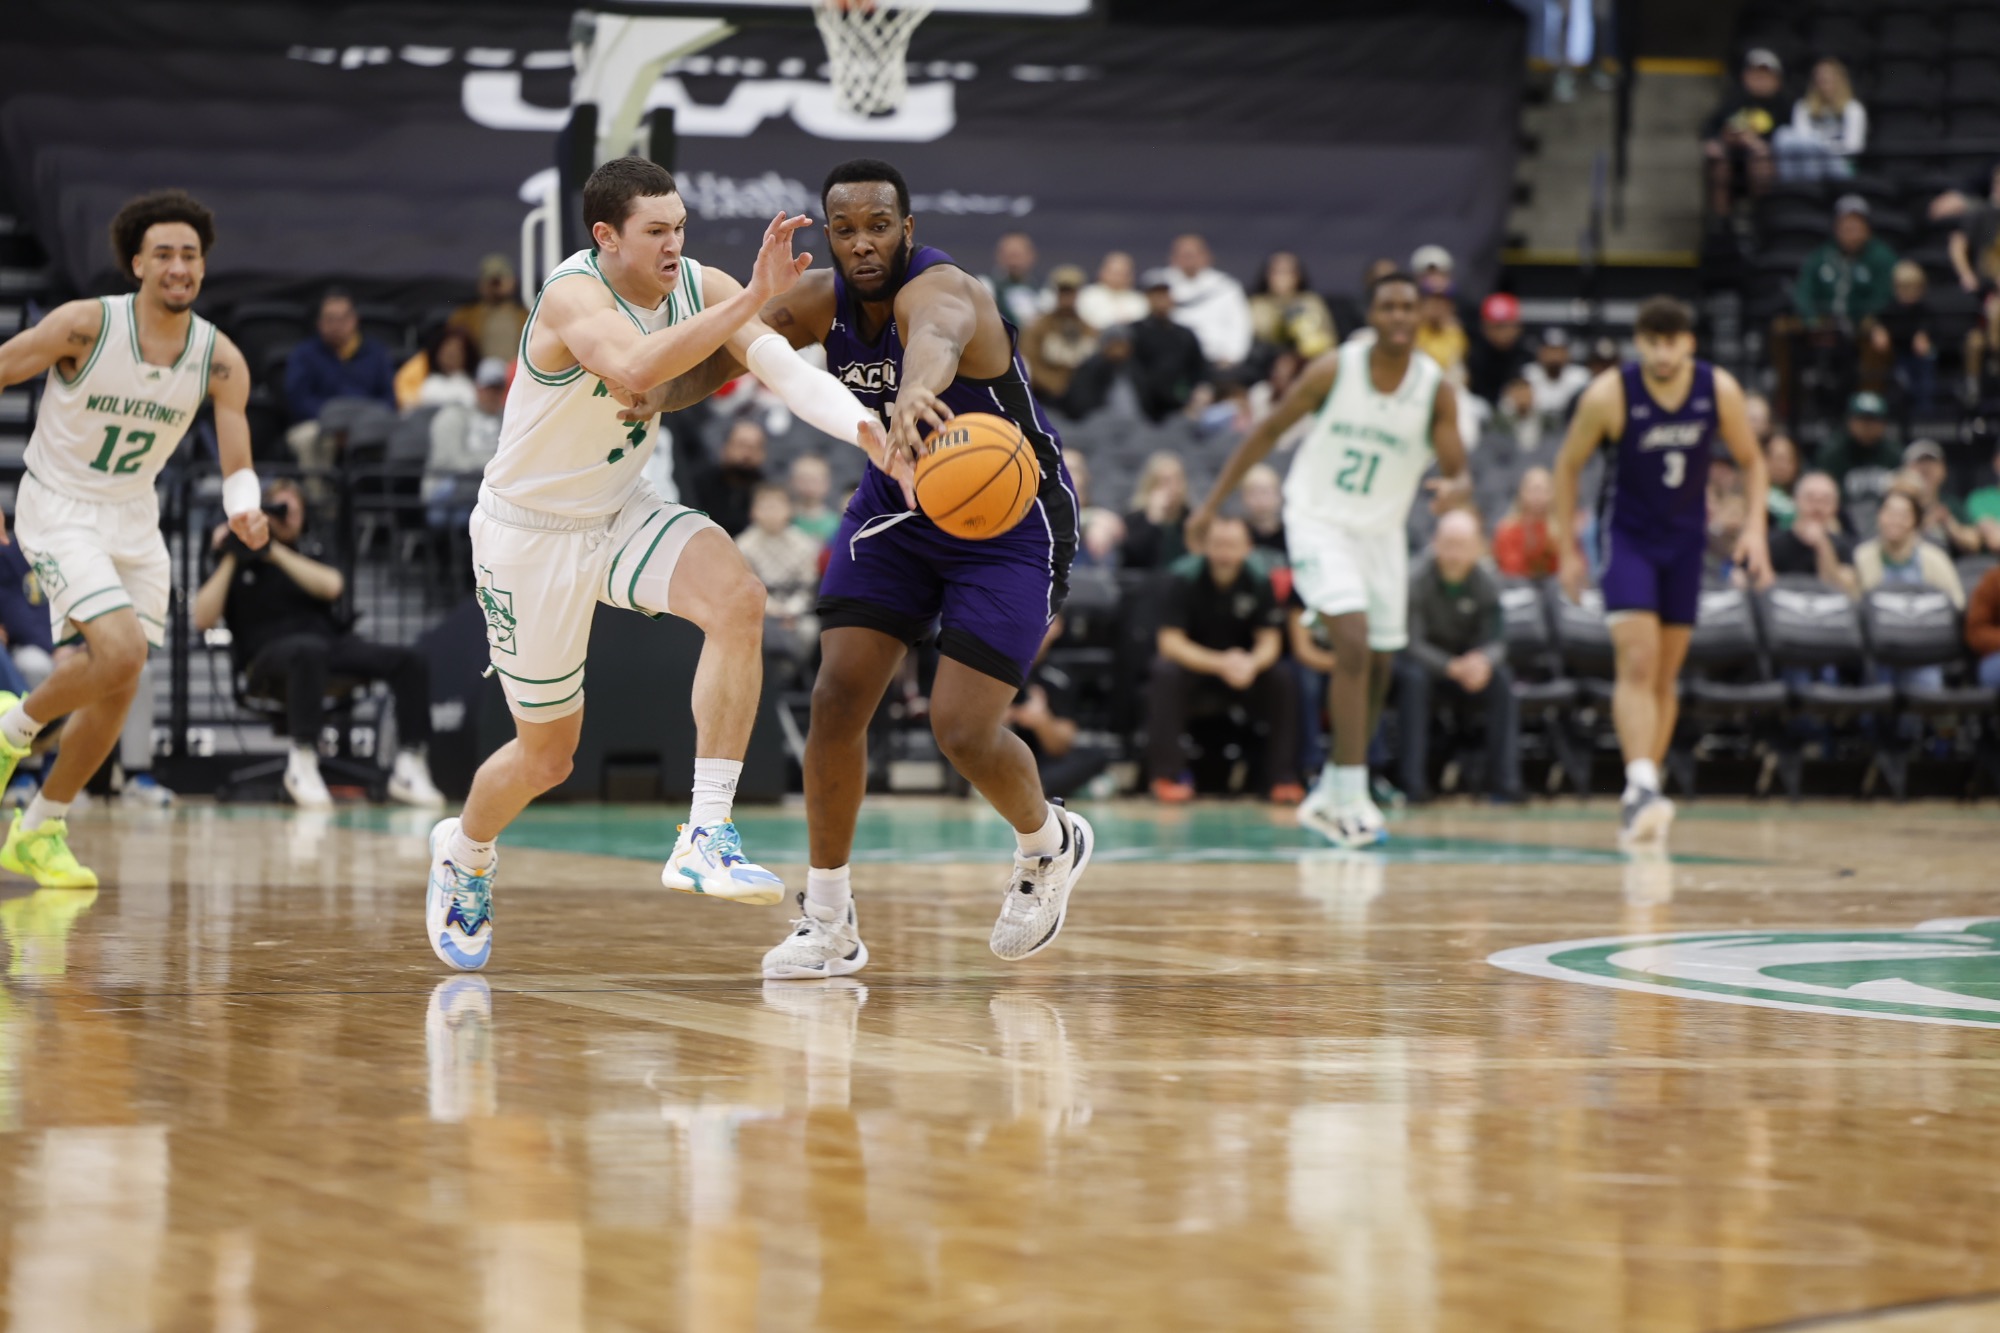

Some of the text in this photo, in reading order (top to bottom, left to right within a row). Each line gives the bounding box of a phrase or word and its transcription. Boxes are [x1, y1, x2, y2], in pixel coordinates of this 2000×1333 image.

[840, 361, 898, 391] ACU
[88, 424, 157, 475] 12
[1662, 451, 1687, 489] 3
[1336, 449, 1380, 494] 21
